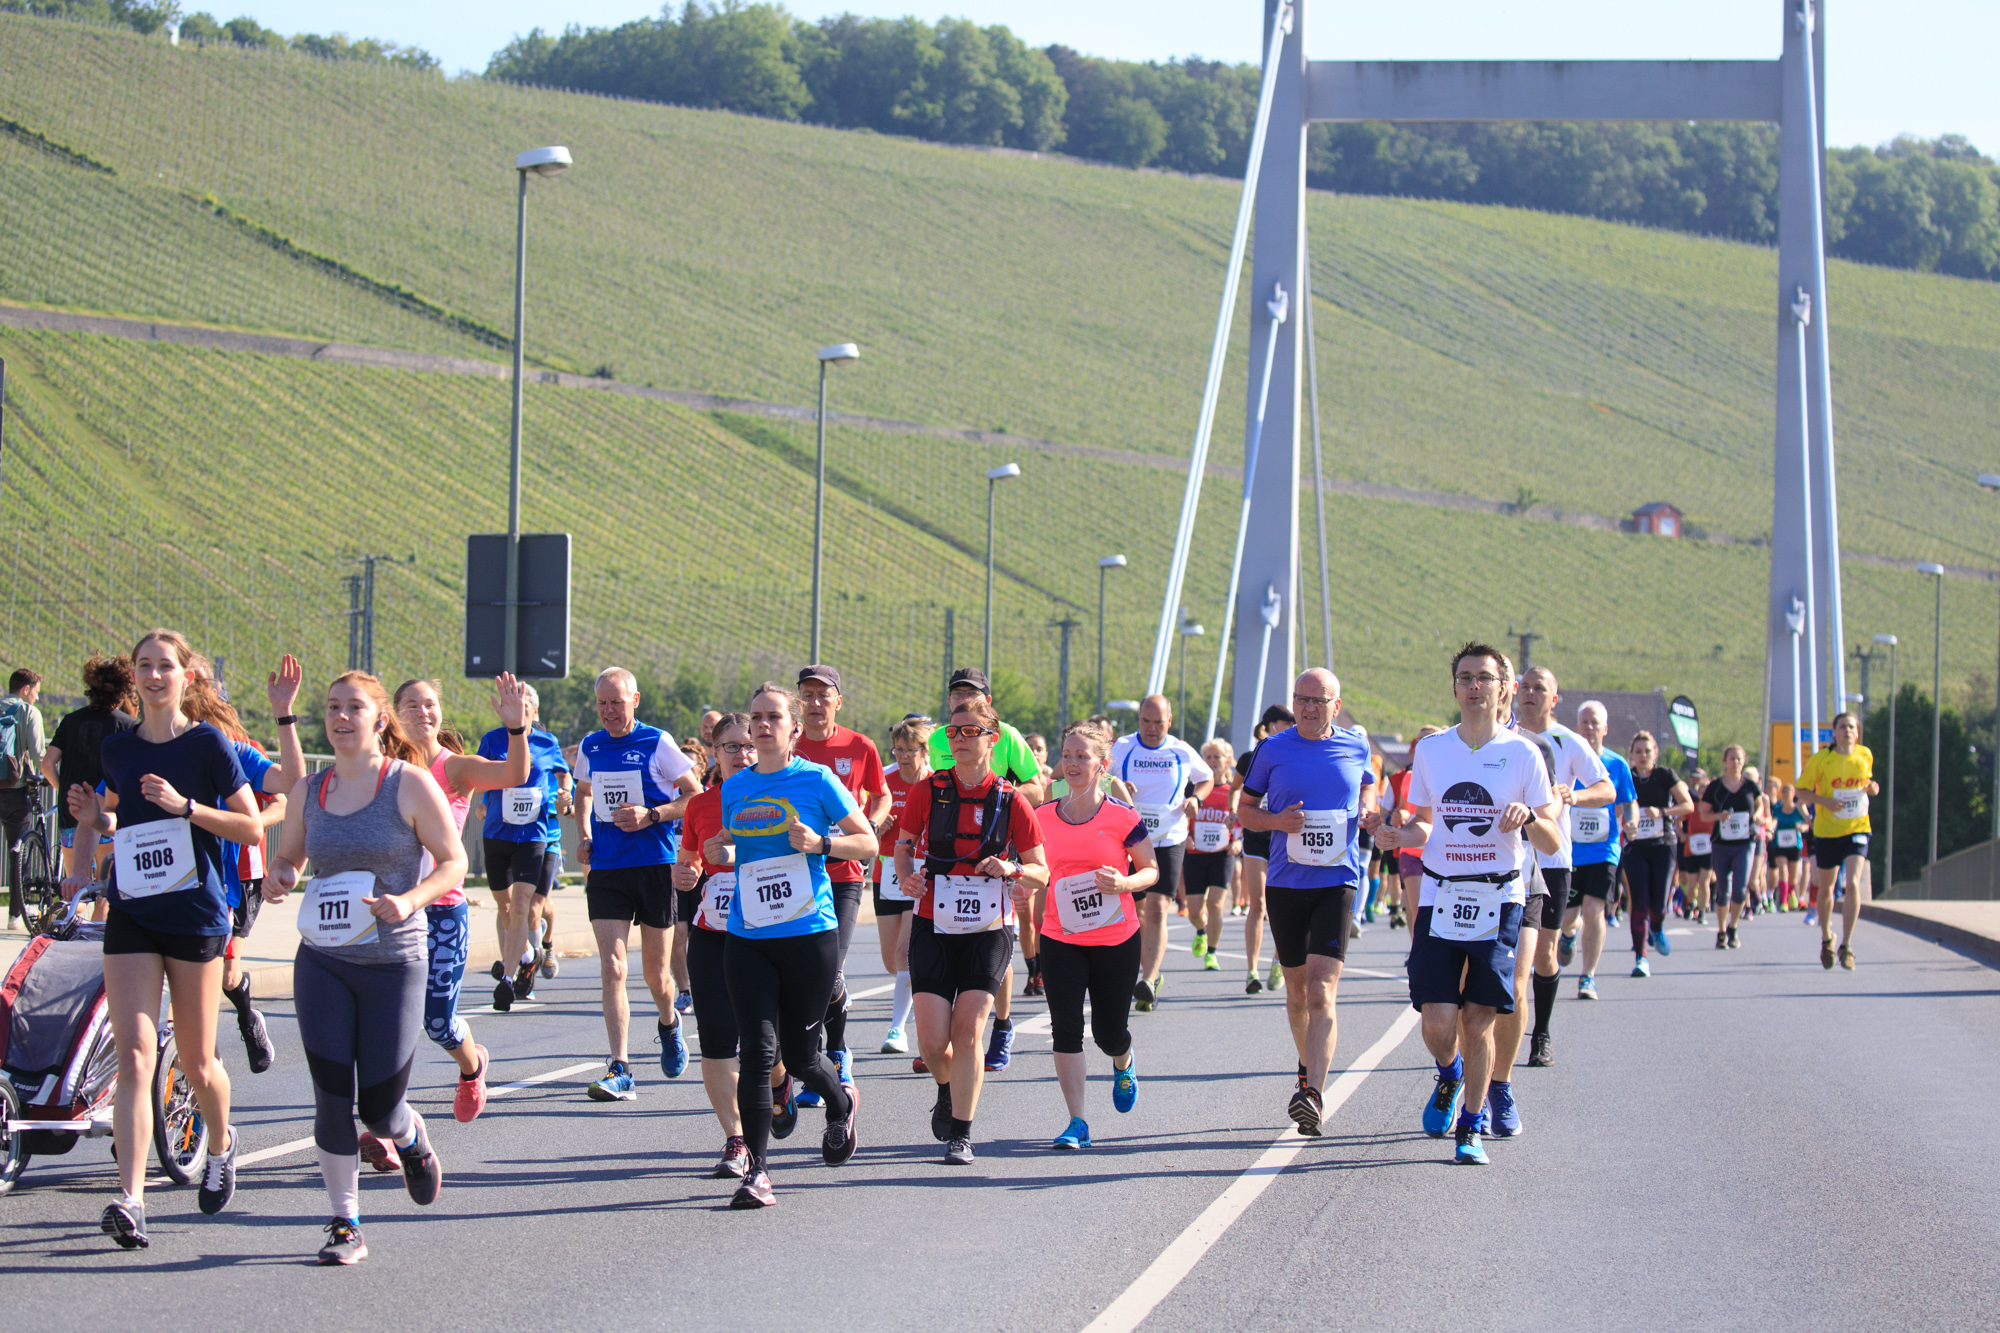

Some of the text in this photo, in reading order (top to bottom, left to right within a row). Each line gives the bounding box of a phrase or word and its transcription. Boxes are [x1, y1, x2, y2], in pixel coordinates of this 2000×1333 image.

[1134, 760, 1174, 768] ERDINGER
[603, 791, 628, 804] 1327
[513, 802, 533, 812] 2077
[735, 810, 780, 820] BRUCHSAL
[1142, 818, 1159, 828] 159
[1580, 821, 1599, 831] 2201
[136, 838, 168, 848] Halbmarathon
[1204, 834, 1220, 842] 2124
[1300, 832, 1333, 847] 1353
[133, 847, 174, 871] 1808
[1446, 852, 1496, 861] FINISHER
[144, 870, 167, 880] Yvonne
[757, 872, 787, 882] Halbmarathon
[756, 881, 792, 903] 1783
[714, 895, 730, 910] 12
[770, 902, 784, 910] Imke
[955, 898, 981, 914] 129
[1072, 892, 1102, 912] 1547
[318, 900, 349, 920] 1717
[1082, 911, 1100, 919] Marina
[1453, 904, 1480, 920] 367
[319, 922, 351, 931] Florentine
[14, 1082, 40, 1091] THULE
